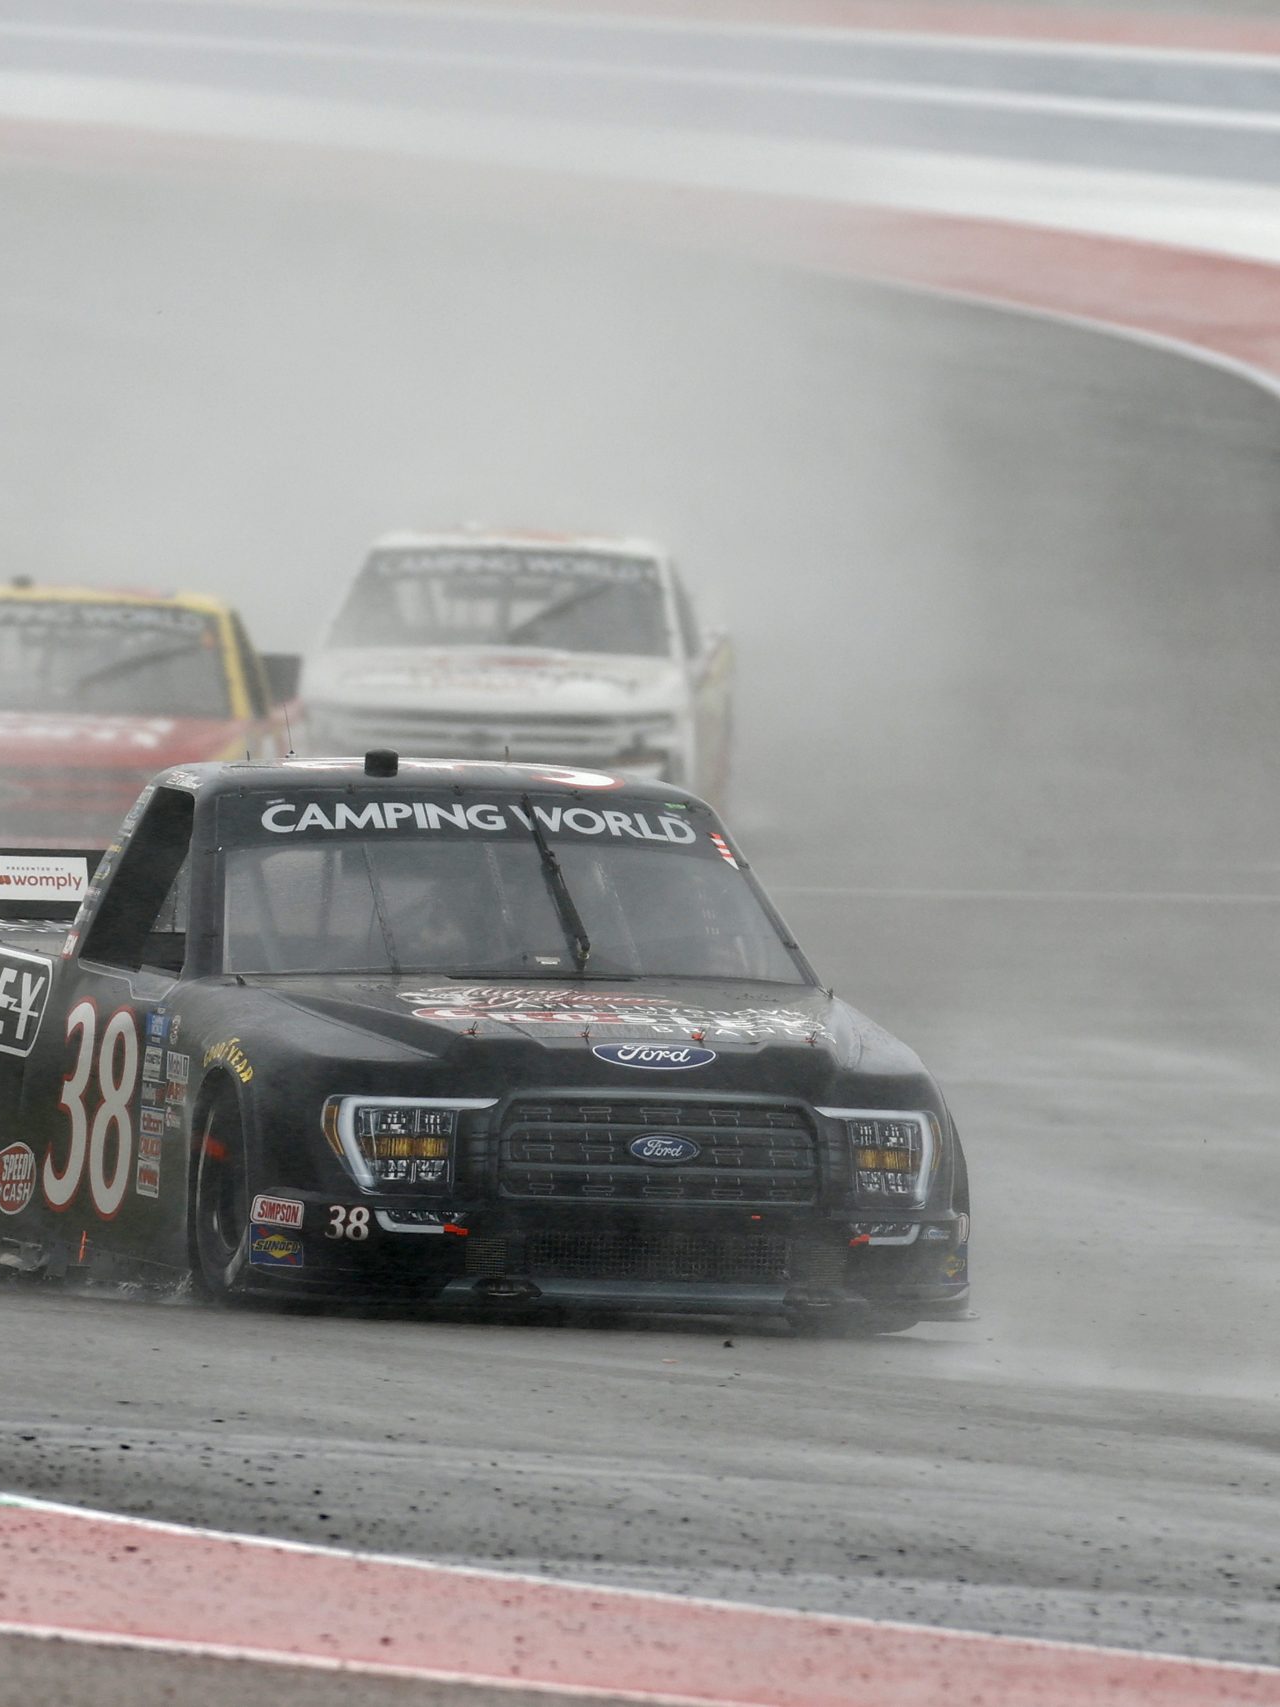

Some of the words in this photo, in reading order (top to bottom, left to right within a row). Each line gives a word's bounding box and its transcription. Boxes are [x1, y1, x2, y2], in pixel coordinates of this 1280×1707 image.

[261, 802, 507, 833] CAMPING
[510, 804, 696, 844] WORLD
[12, 872, 82, 890] womply
[434, 1008, 812, 1027] CROSLEY
[617, 1044, 691, 1062] Ford
[42, 998, 139, 1218] 38
[643, 1139, 683, 1157] Ford
[2, 1153, 34, 1181] SPEEDY
[3, 1183, 31, 1202] CASH
[258, 1200, 299, 1223] SIMPSON
[324, 1205, 370, 1240] 38
[253, 1240, 299, 1252] SUNOCO
